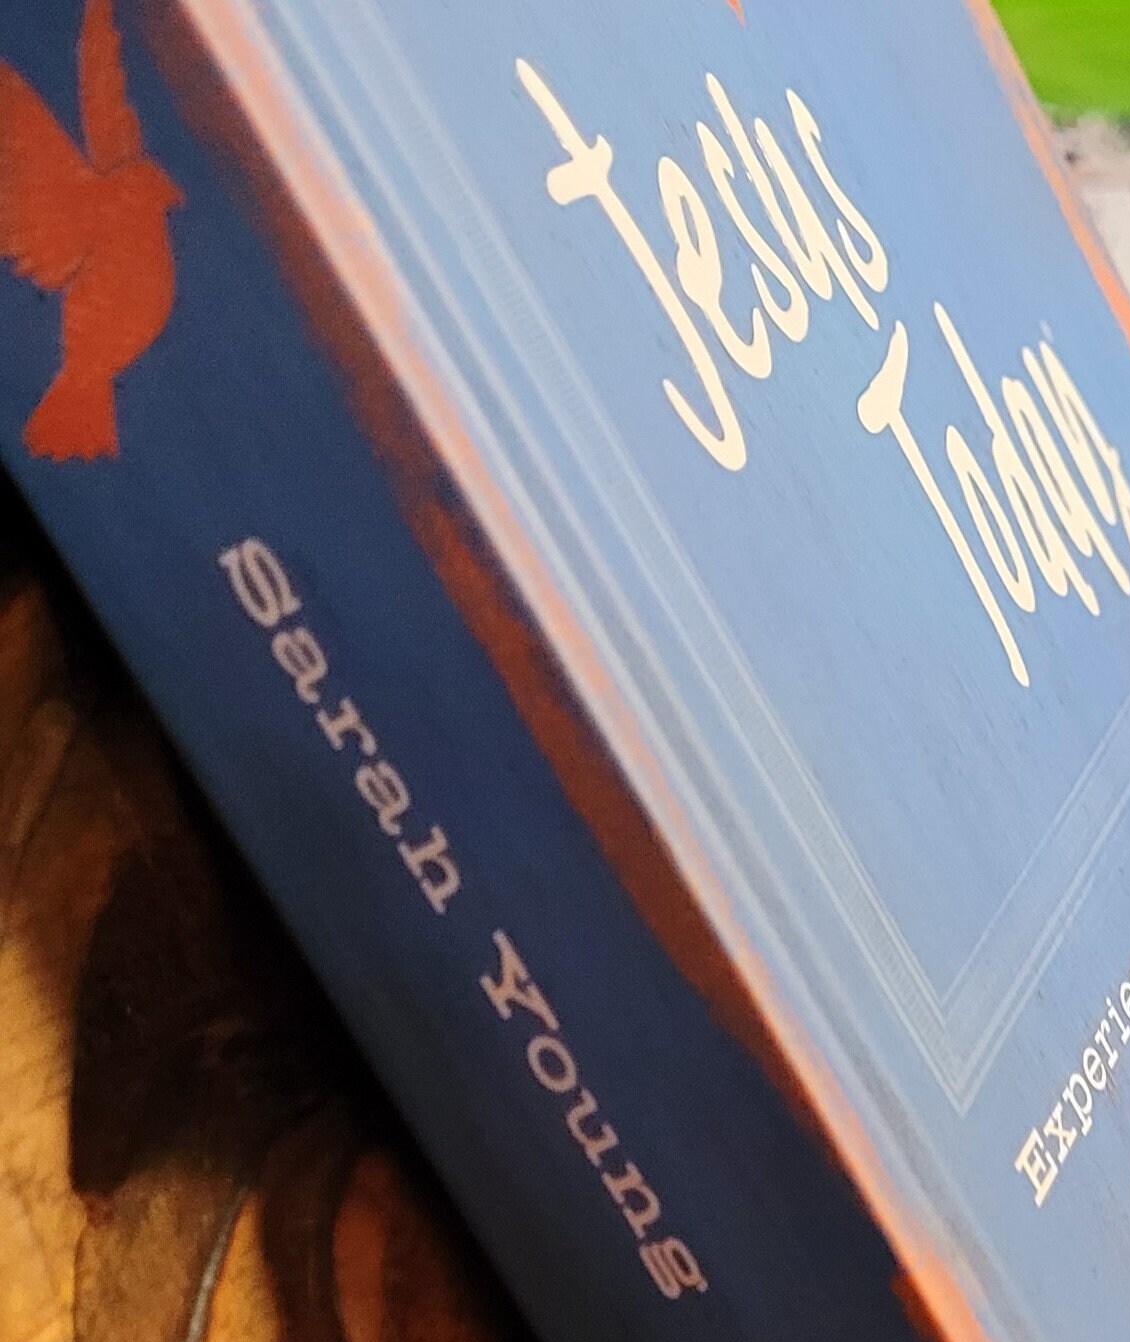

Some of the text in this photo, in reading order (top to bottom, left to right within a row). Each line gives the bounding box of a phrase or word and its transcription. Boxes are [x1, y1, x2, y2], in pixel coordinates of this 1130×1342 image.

[515, 57, 888, 471] Jesus
[217, 537, 708, 1301] Sarah Young
